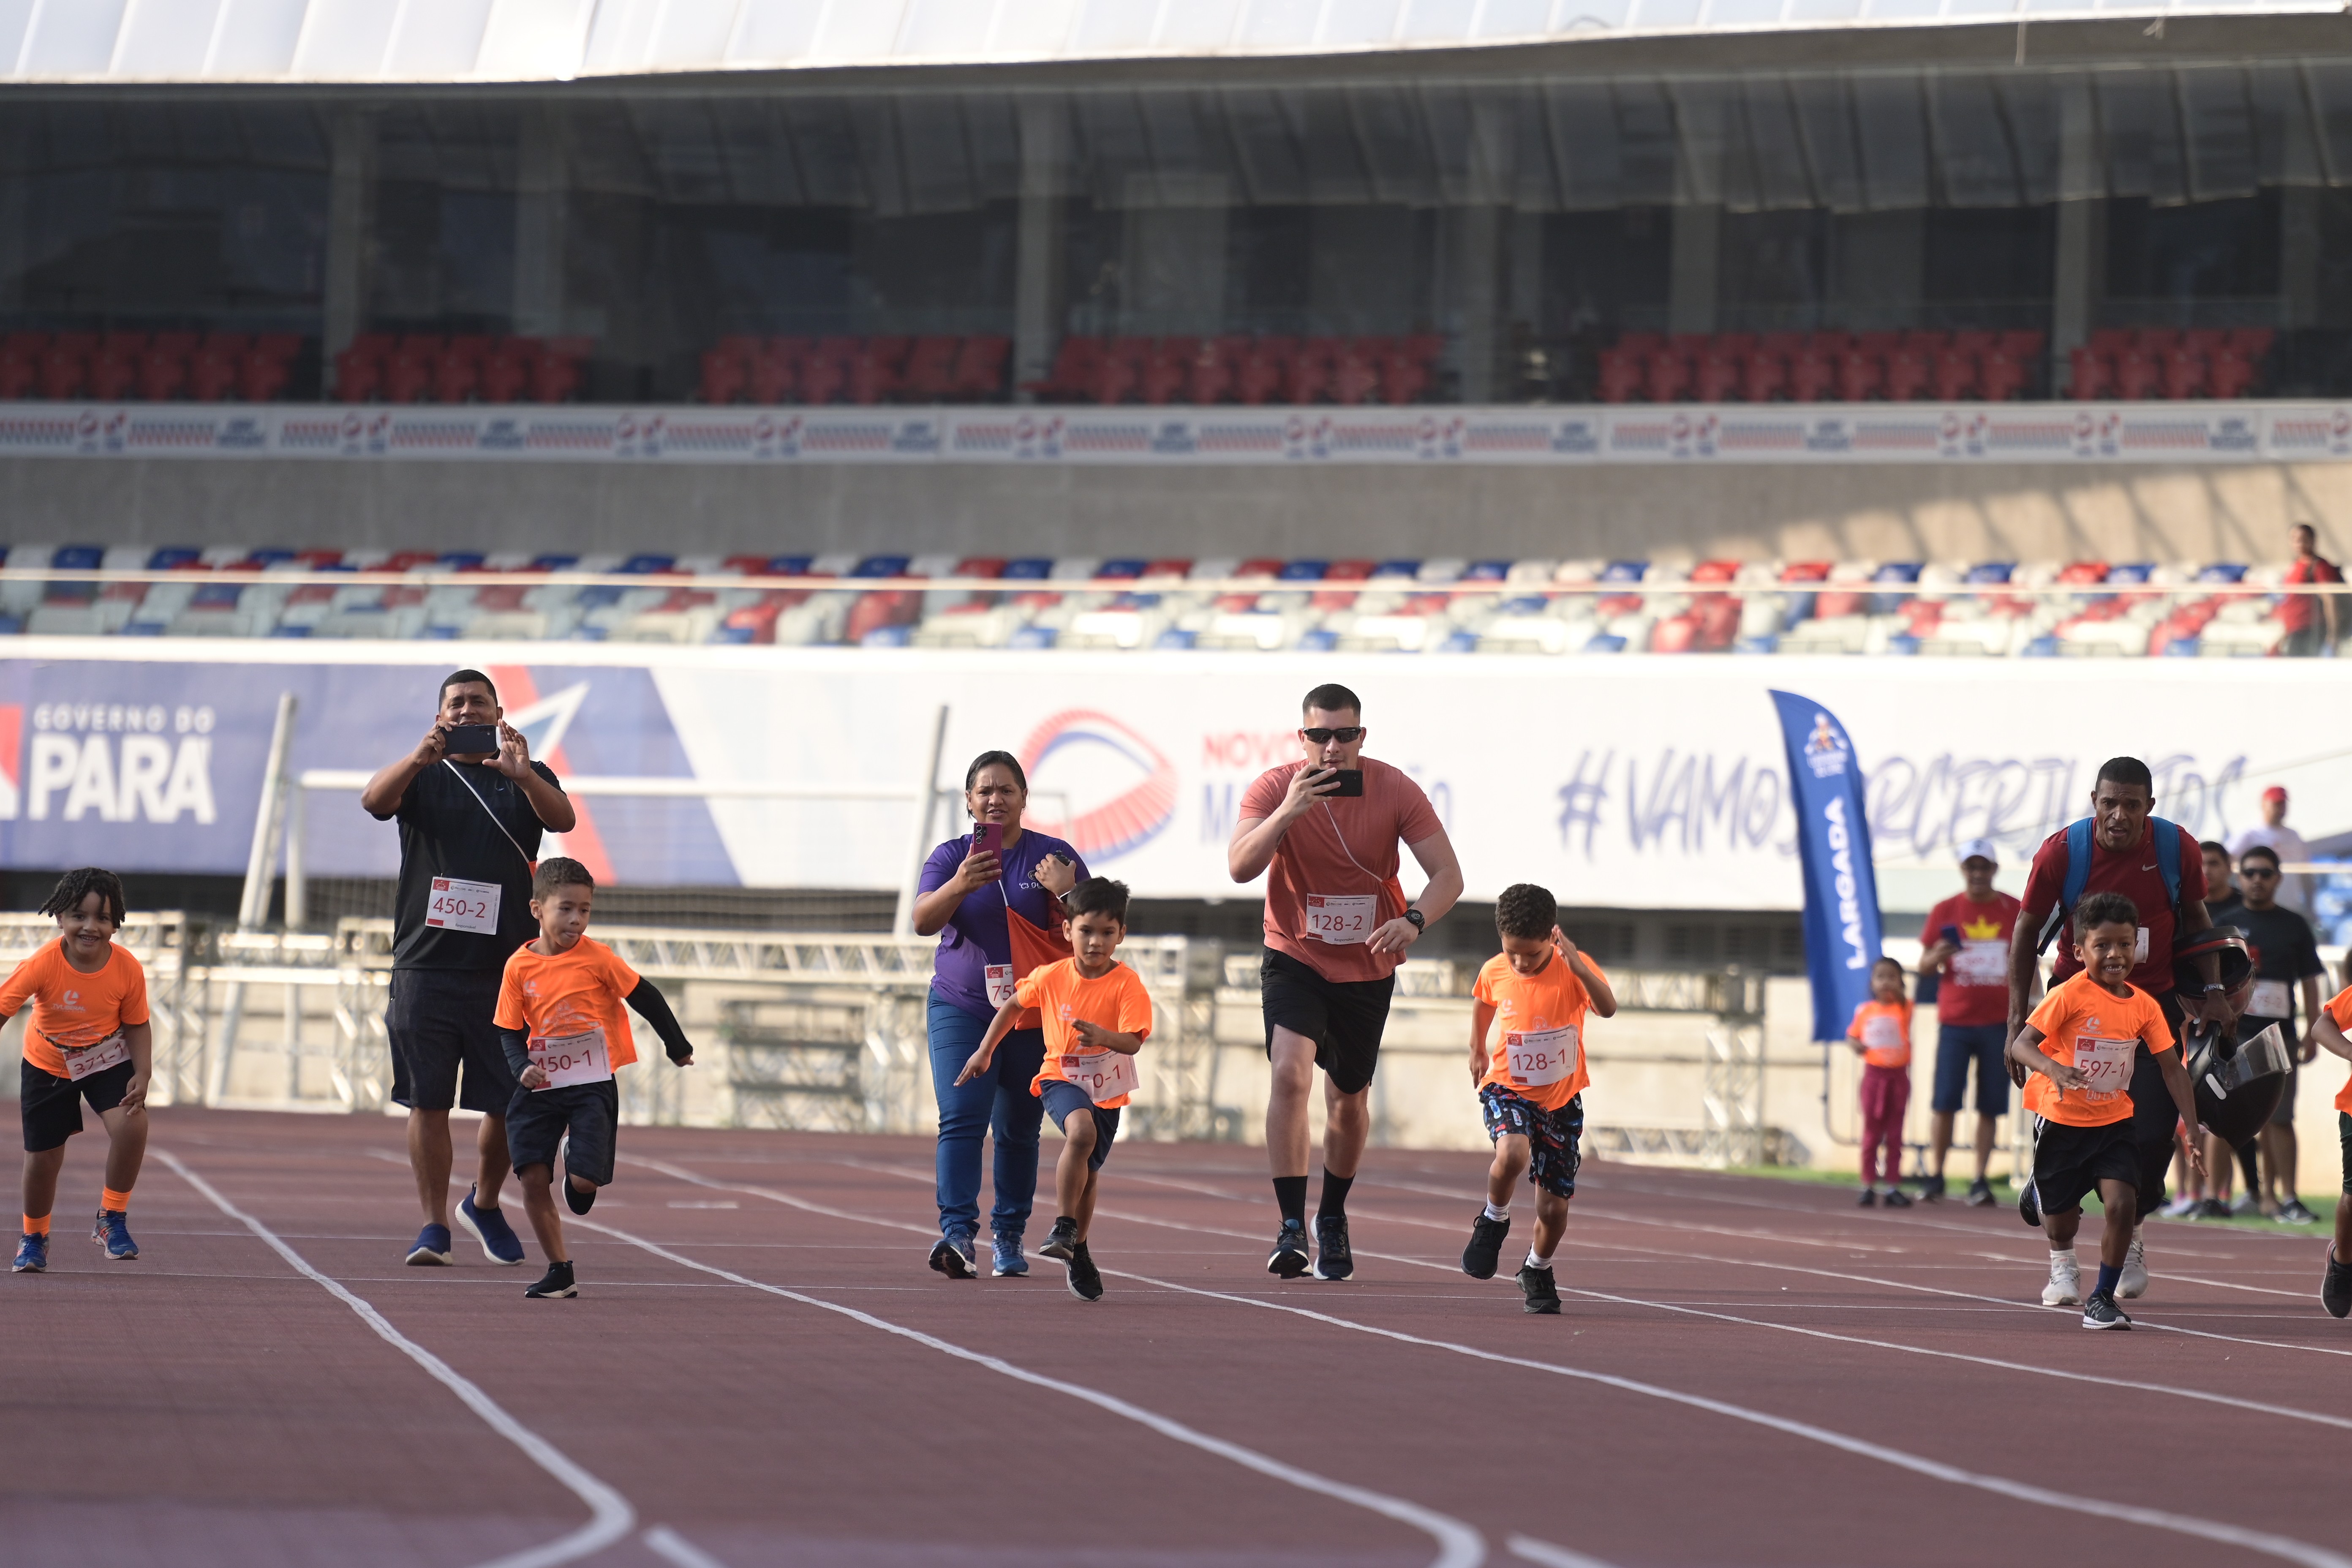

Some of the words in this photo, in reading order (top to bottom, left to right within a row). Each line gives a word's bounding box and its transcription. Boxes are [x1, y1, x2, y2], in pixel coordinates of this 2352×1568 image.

[34, 704, 166, 732] GOVERNO
[176, 706, 215, 734] DO
[1202, 732, 1302, 767] NOVO
[1823, 796, 1867, 969] LARGADA
[433, 897, 485, 918] 450-2
[1312, 915, 1362, 931] 128-2
[74, 1043, 123, 1075] 371-1
[1513, 1049, 1565, 1071] 128-1
[2080, 1059, 2125, 1078] 597-1
